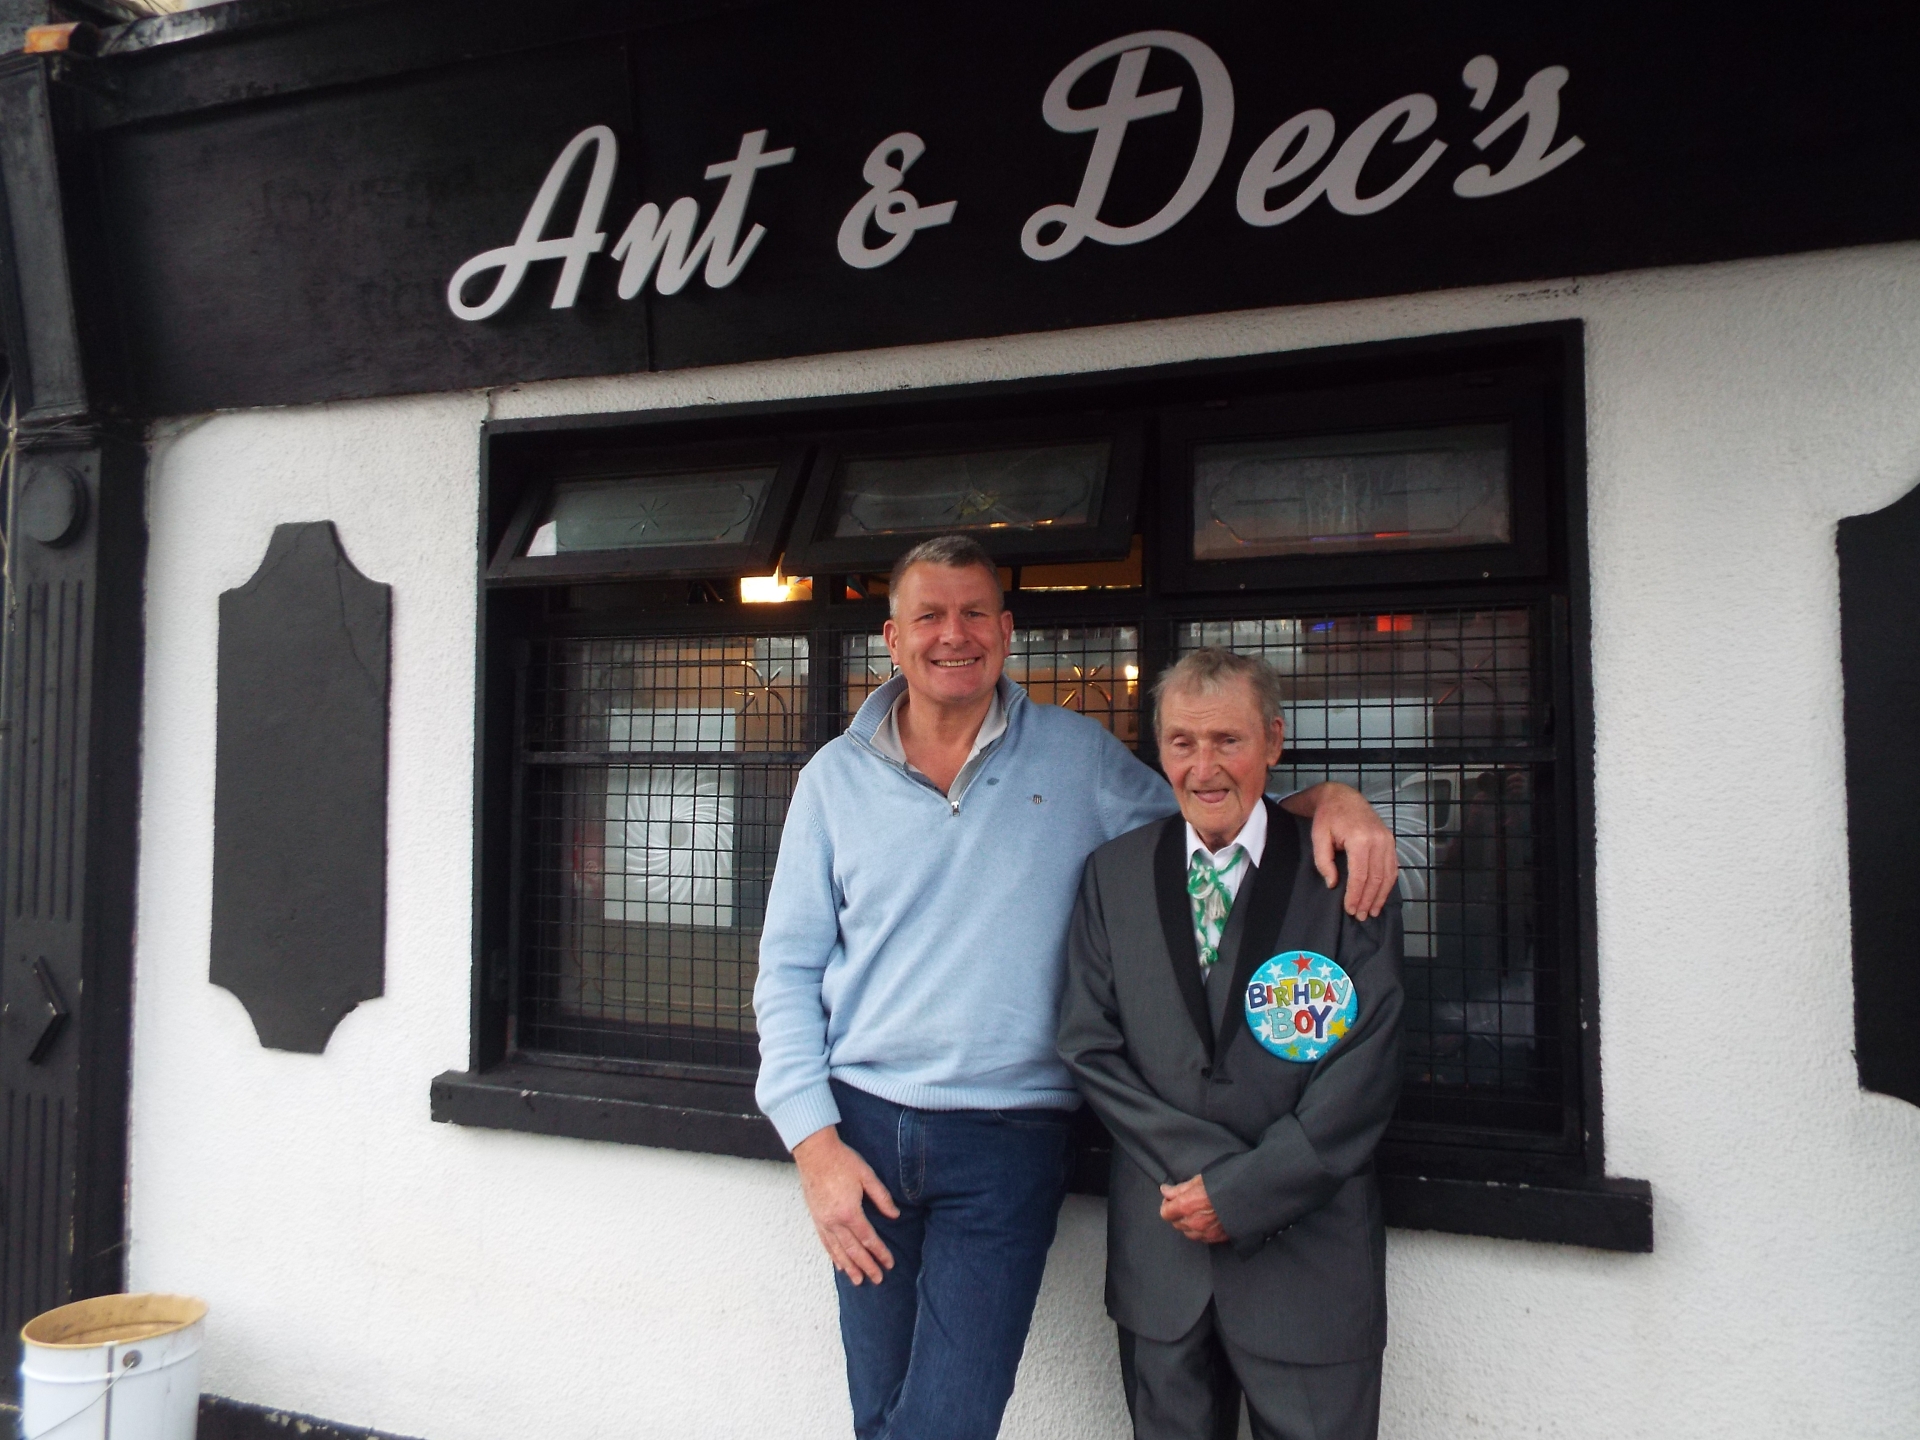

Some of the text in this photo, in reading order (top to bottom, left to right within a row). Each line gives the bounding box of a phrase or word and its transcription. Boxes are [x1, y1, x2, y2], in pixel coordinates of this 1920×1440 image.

[448, 29, 1586, 321] Ant & Dec's
[1248, 978, 1350, 1009] BIRTHDAY
[1268, 1004, 1333, 1040] BOY
